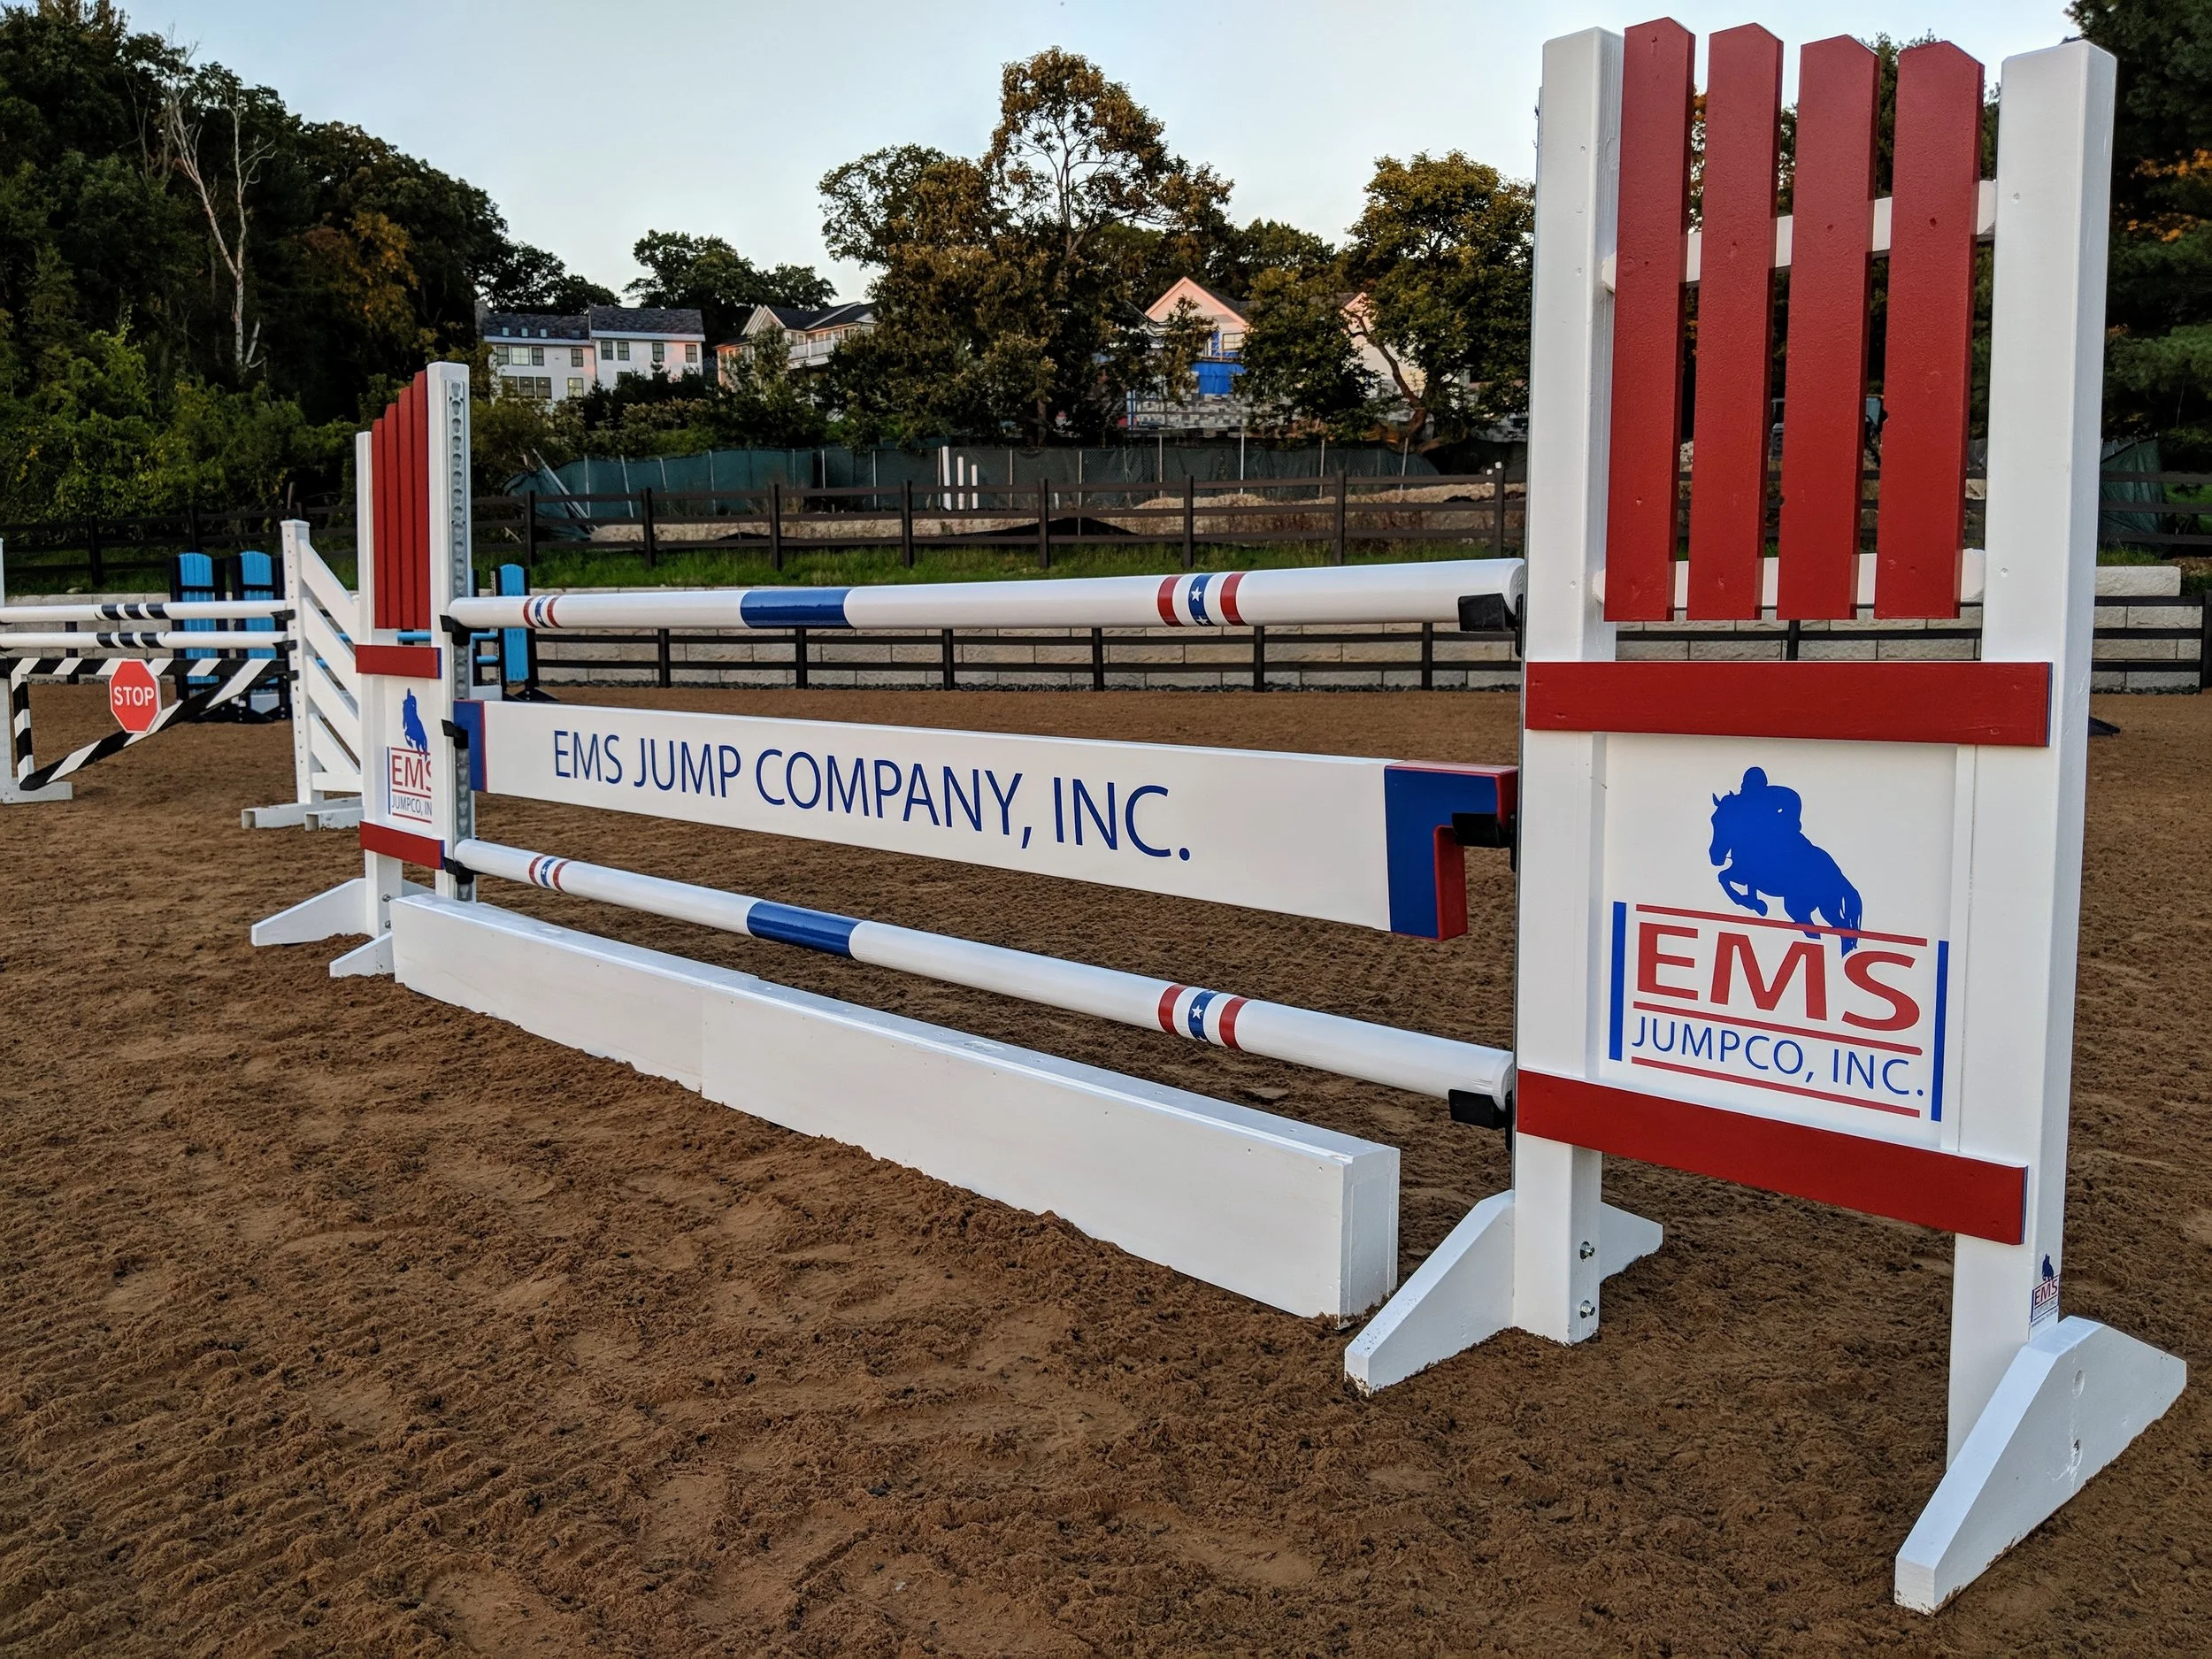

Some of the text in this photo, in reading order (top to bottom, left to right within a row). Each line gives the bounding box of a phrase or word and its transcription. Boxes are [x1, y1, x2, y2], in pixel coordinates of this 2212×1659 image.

[113, 686, 155, 706] STOP
[392, 795, 423, 816] JUMPCO,
[553, 729, 1191, 862] EMS JUMP COMPANY, INC.
[1637, 921, 1921, 1032] EMS
[1632, 1016, 1924, 1097] JUMPCO, INC.
[2034, 1279, 2058, 1306] EMS
